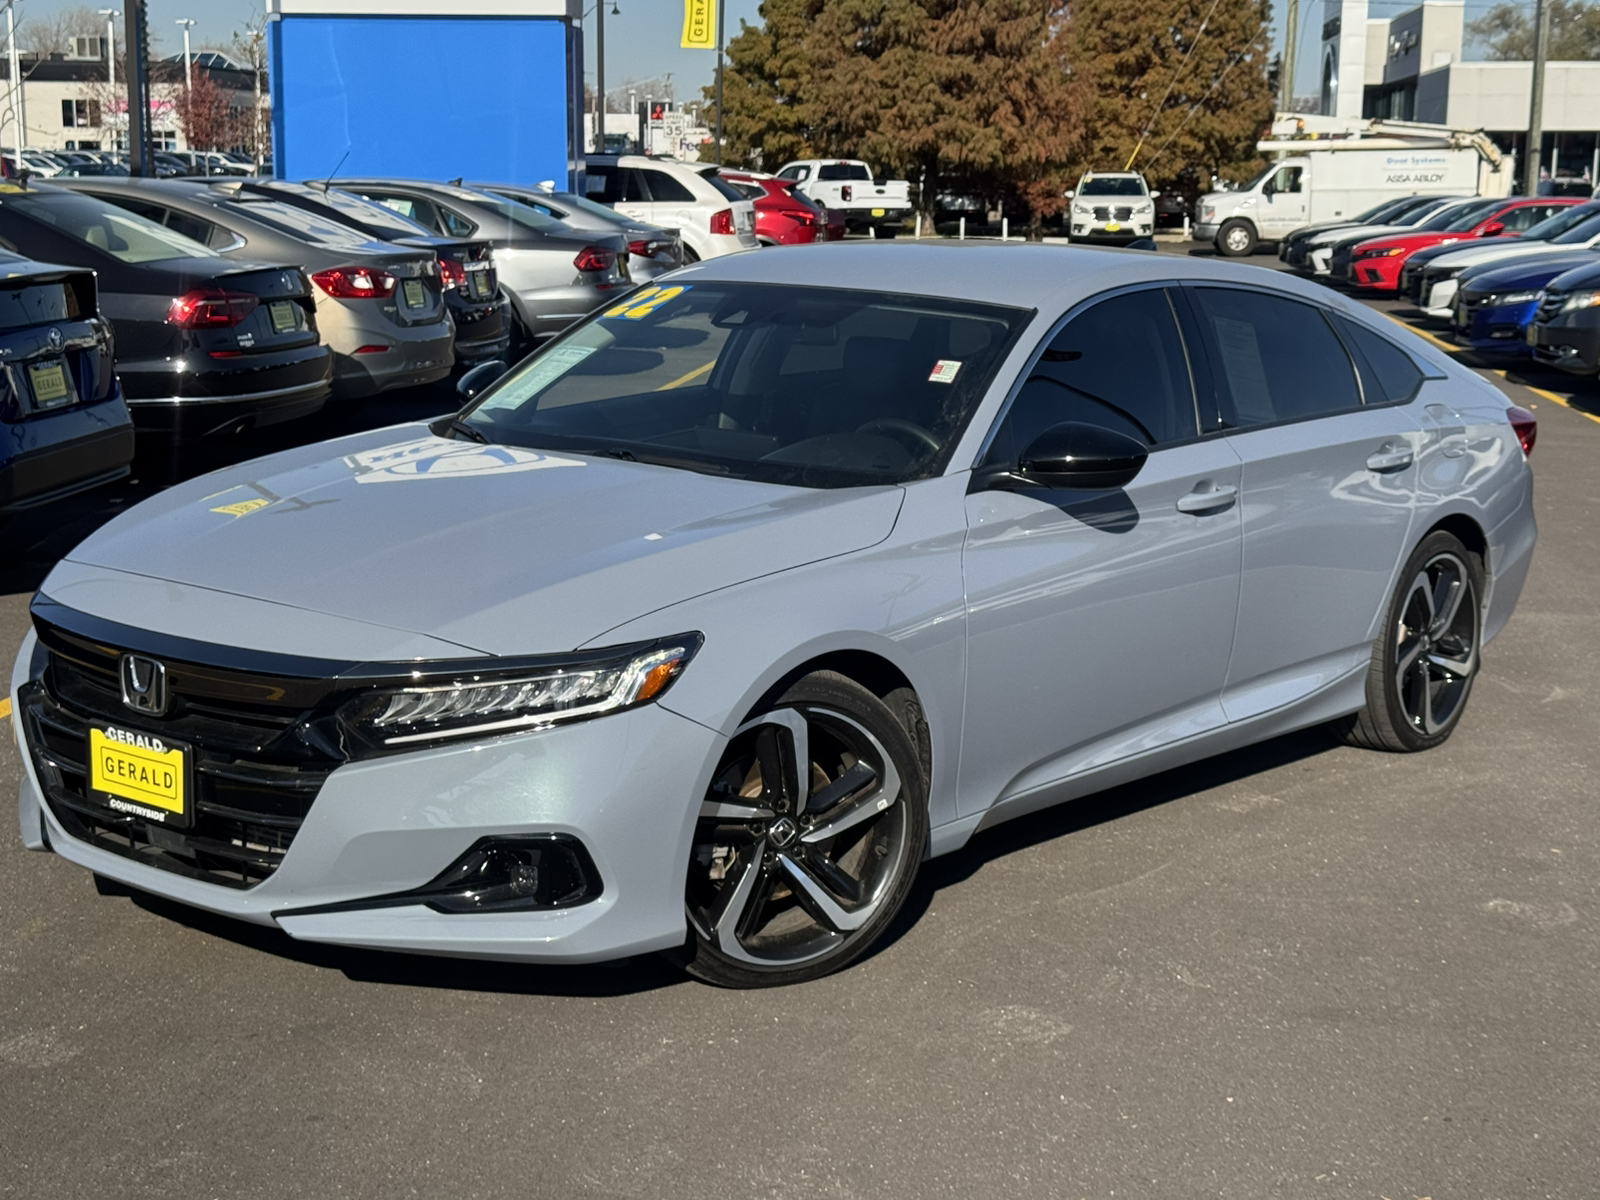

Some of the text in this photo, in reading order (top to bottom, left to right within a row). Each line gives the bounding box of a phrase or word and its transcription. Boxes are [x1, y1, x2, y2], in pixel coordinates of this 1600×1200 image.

[666, 126, 682, 136] 35
[602, 286, 684, 319] 22
[106, 726, 164, 752] GERALD
[105, 756, 173, 789] GERALD
[109, 798, 165, 822] COUNTRYSIDE
